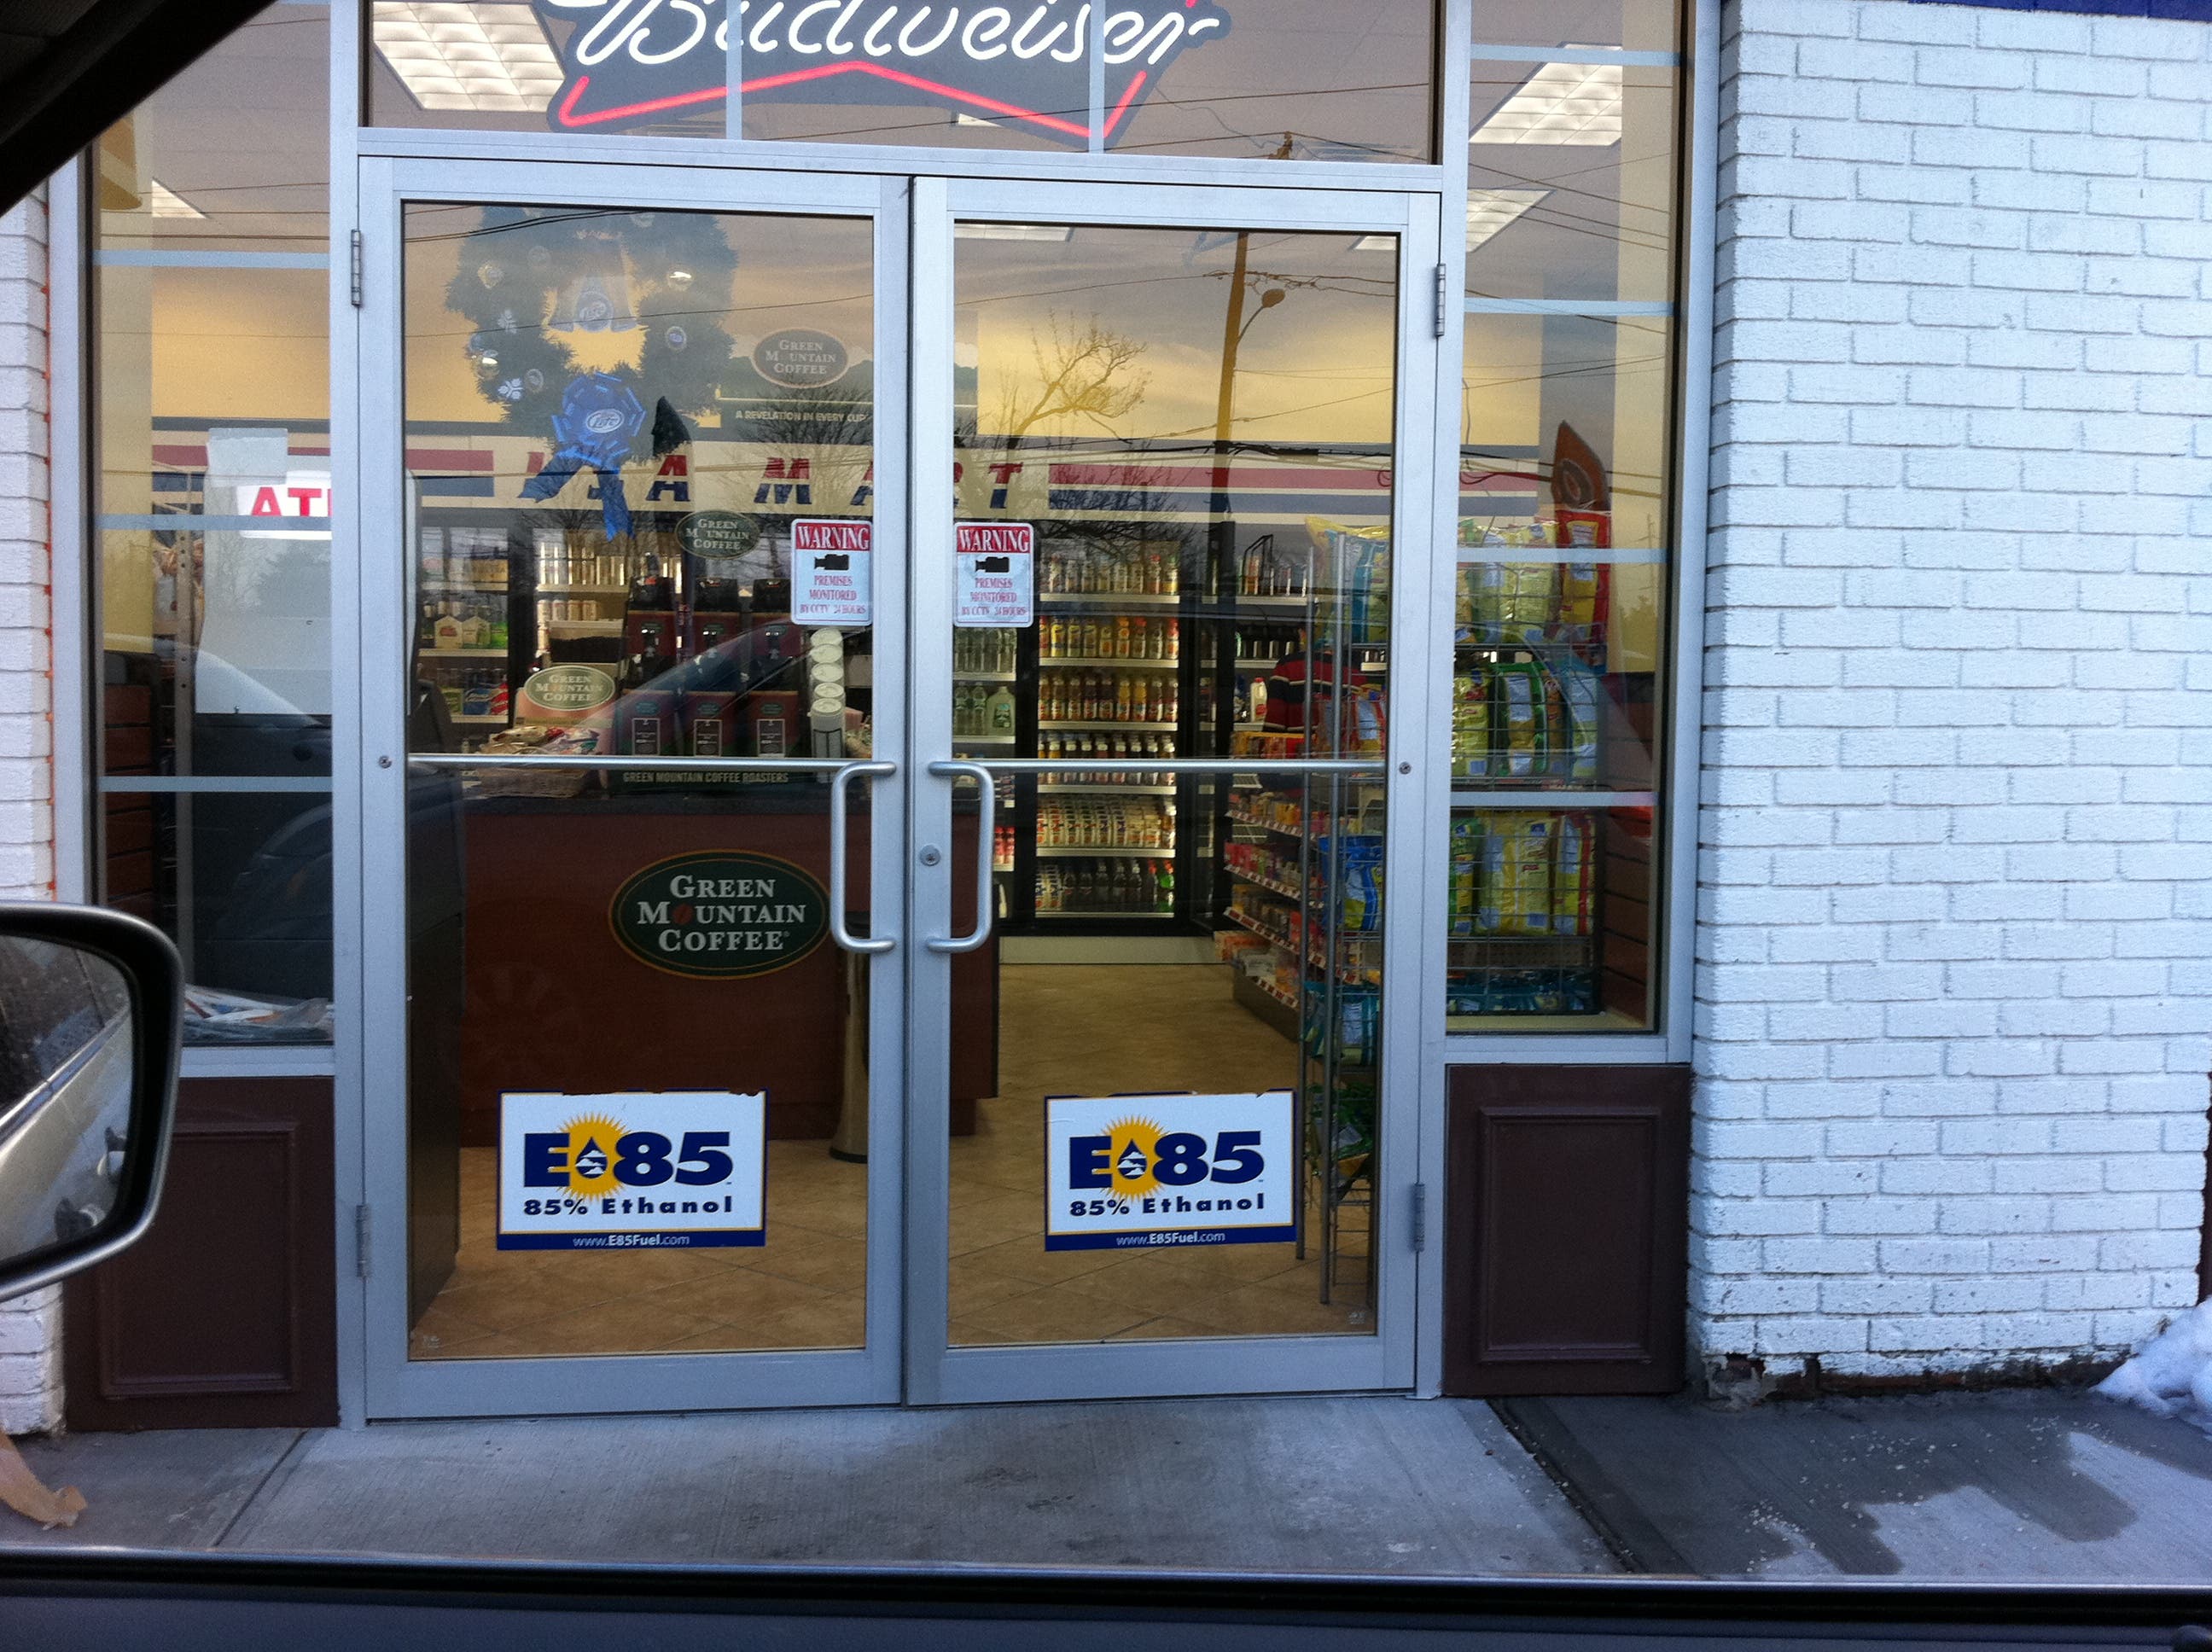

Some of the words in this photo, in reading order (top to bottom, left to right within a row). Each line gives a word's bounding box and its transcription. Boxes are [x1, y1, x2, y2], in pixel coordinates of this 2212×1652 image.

[551, 0, 1220, 65] Budweiser
[779, 340, 824, 351] GREEN
[765, 350, 835, 363] MUNTAIN
[773, 363, 827, 375] COFFEE
[736, 410, 742, 419] A
[745, 410, 800, 421] REVELATION
[816, 413, 844, 422] EVERY
[251, 486, 331, 517] AT
[698, 519, 738, 529] GREEN
[685, 527, 750, 540] MUNTAIN
[797, 526, 869, 550] WARNING
[694, 538, 741, 550] COFFEE
[958, 530, 1029, 552] WARNING
[814, 575, 853, 586] PREMISES
[975, 578, 1013, 588] PREMISES
[809, 590, 857, 601] MONITORED
[970, 592, 1017, 602] MONITORED
[549, 674, 591, 683] GREEN
[544, 692, 593, 702] COFFEE
[623, 772, 654, 782] GREEN
[655, 772, 703, 782] MOUNTAIN
[707, 772, 741, 782] COFFEE
[743, 773, 789, 783] ROASTERS
[670, 875, 776, 899] GREEN
[637, 901, 806, 924] MOUNTAIN
[658, 928, 784, 951] COFFEE
[523, 1198, 588, 1216] 85%
[602, 1195, 732, 1214] Ethanol
[1069, 1197, 1130, 1217] 85%
[1143, 1193, 1265, 1214] Ethanol
[573, 1234, 690, 1248] www.E85Fuel.com
[1115, 1230, 1225, 1247] www.E85Fuel.com
